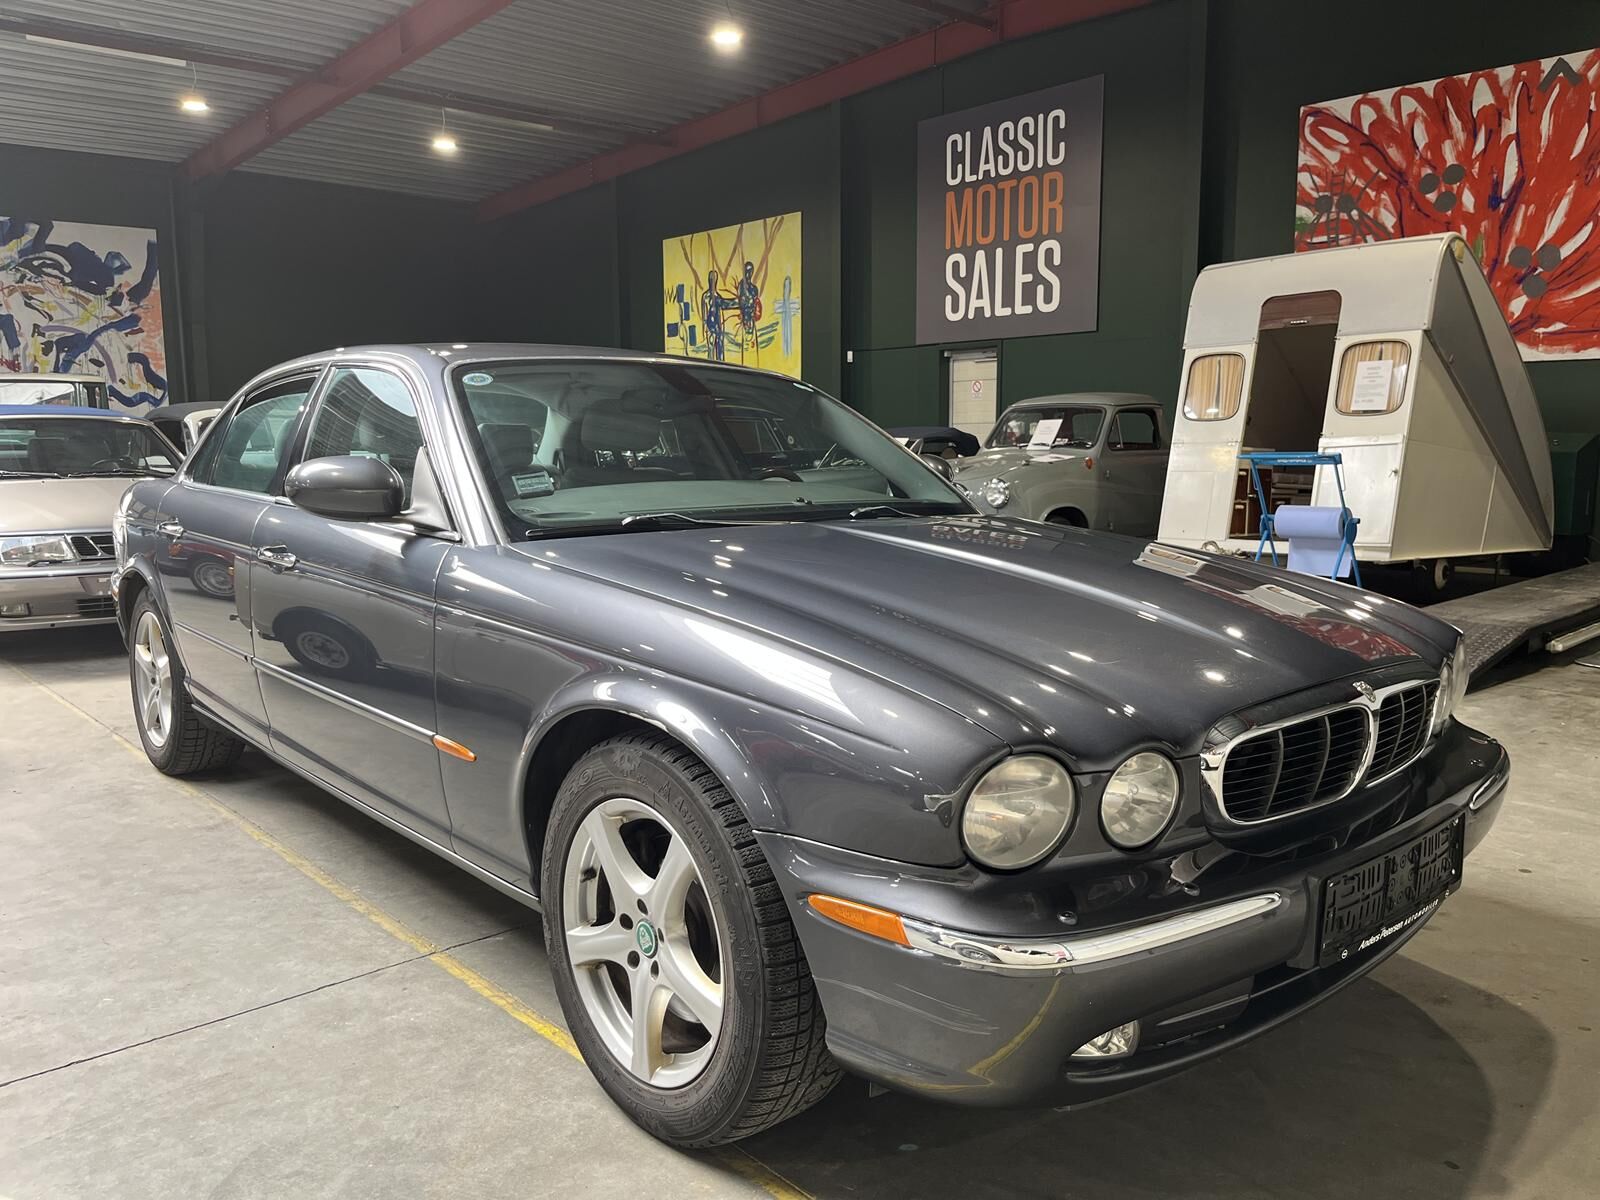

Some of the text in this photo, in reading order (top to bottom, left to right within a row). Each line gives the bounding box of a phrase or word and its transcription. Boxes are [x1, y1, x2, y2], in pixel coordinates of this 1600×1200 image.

[946, 109, 1066, 186] CLASSIC
[945, 171, 1064, 250] MOTOR
[945, 239, 1061, 321] SALES
